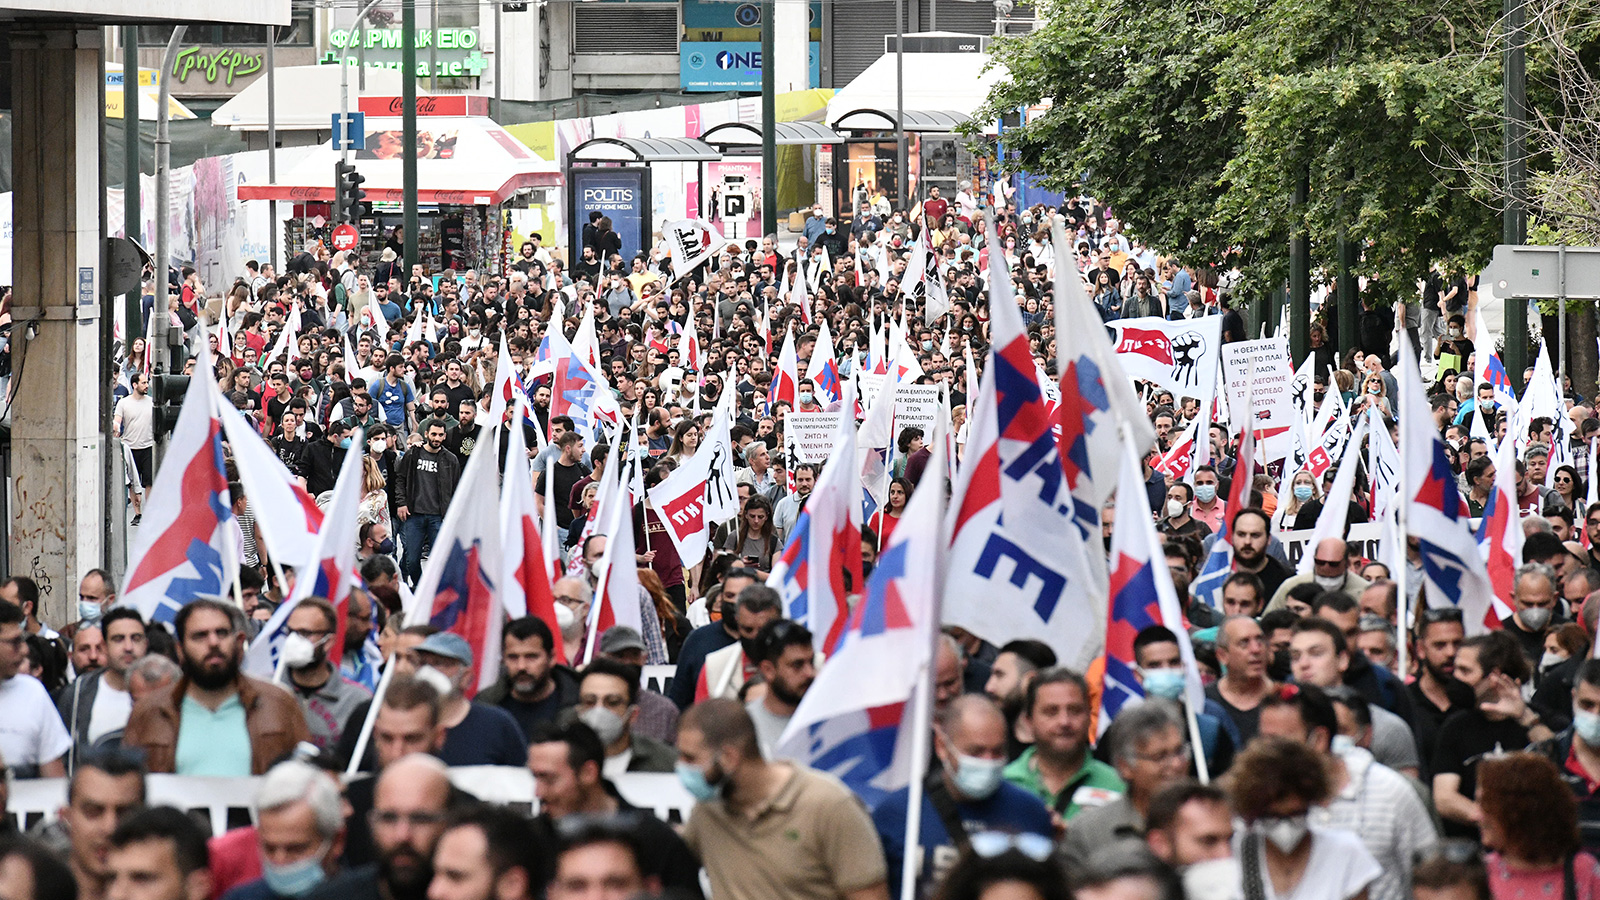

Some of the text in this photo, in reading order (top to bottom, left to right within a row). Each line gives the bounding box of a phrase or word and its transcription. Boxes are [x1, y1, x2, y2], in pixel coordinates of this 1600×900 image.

[329, 28, 478, 49] ΦΑΡΜΚΕΙΟ
[172, 45, 263, 85] Γρηγόρης
[584, 189, 634, 202] POLITIS
[1240, 346, 1259, 354] ΘΕΣΗ
[1260, 343, 1276, 351] ΜΑΣ
[1255, 365, 1276, 373] ΛΑΩΝ
[1231, 380, 1240, 388] ΔΕ
[1252, 398, 1276, 406] ΗΣΤΩΝ
